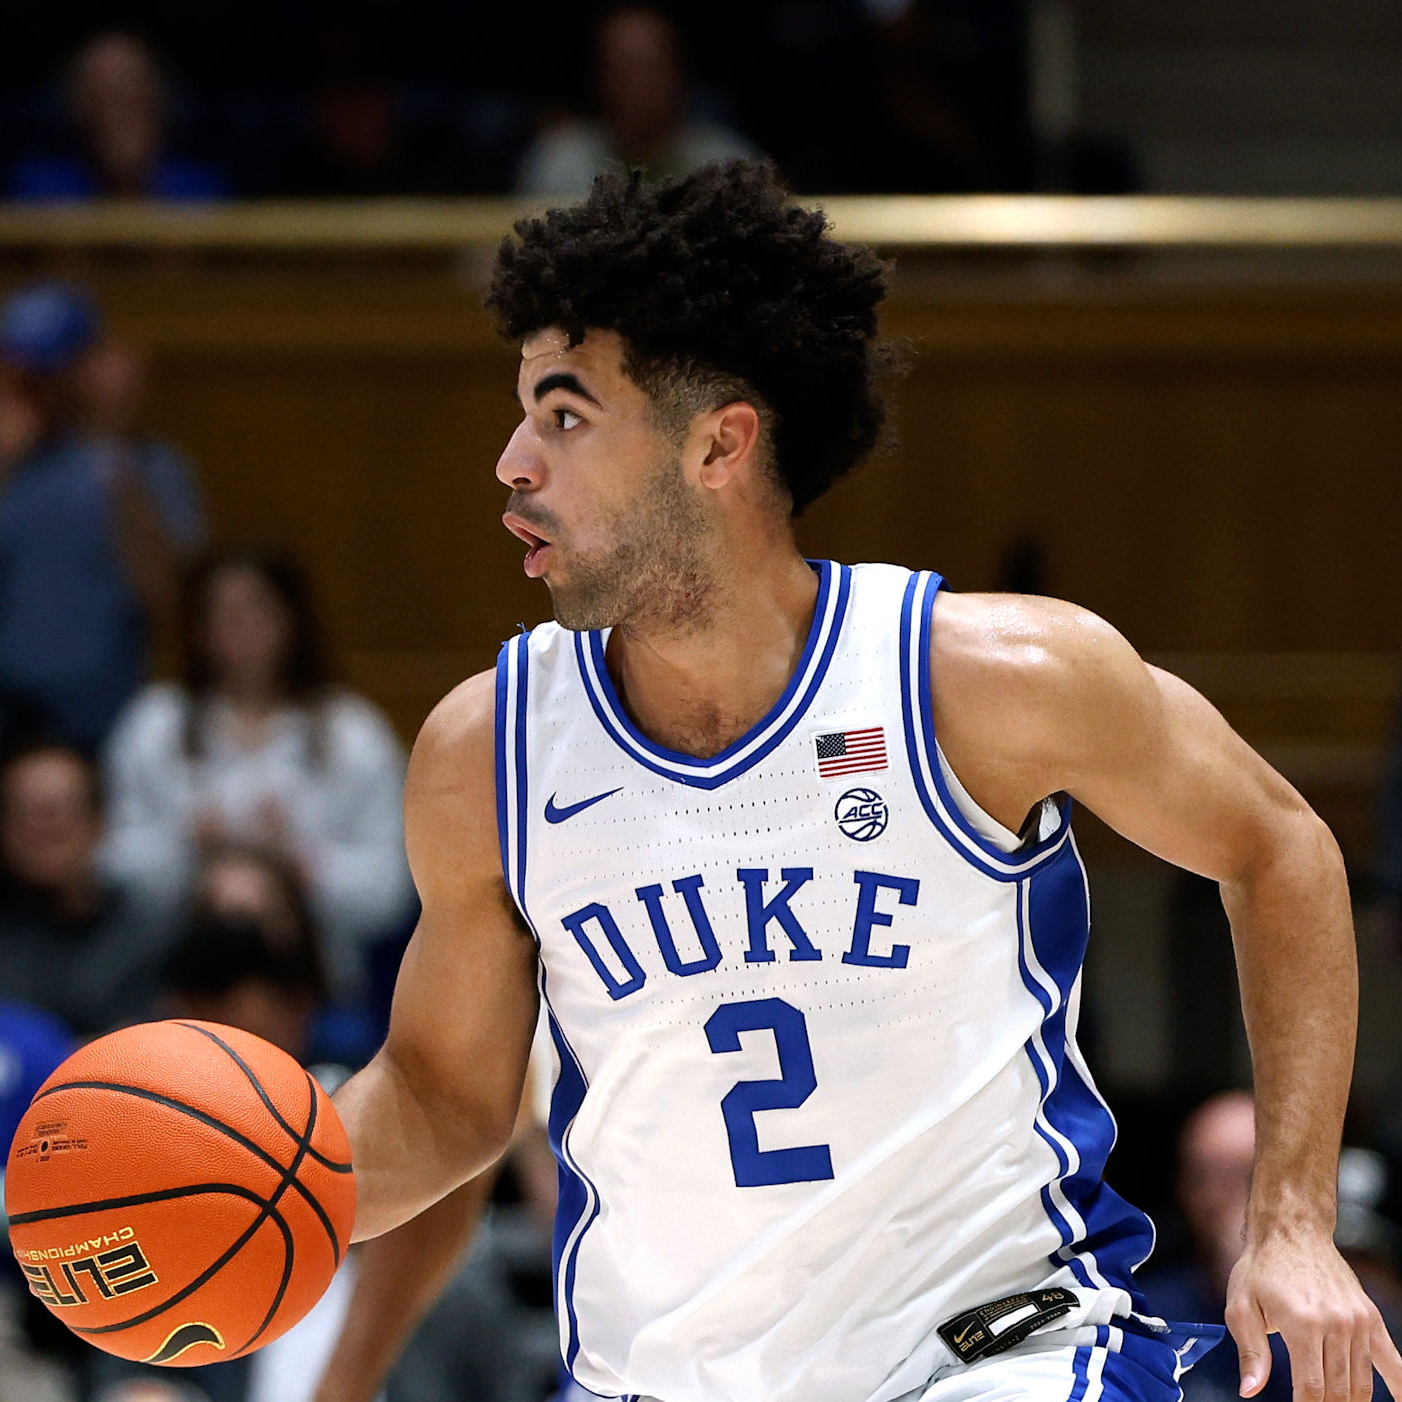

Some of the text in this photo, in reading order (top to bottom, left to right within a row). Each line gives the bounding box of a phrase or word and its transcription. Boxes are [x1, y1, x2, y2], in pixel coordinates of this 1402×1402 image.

[842, 801, 885, 819] ACC
[560, 866, 921, 1002] DUKE
[702, 996, 835, 1188] 2
[21, 1240, 159, 1307] ELITE
[958, 1329, 986, 1352] ELITE
